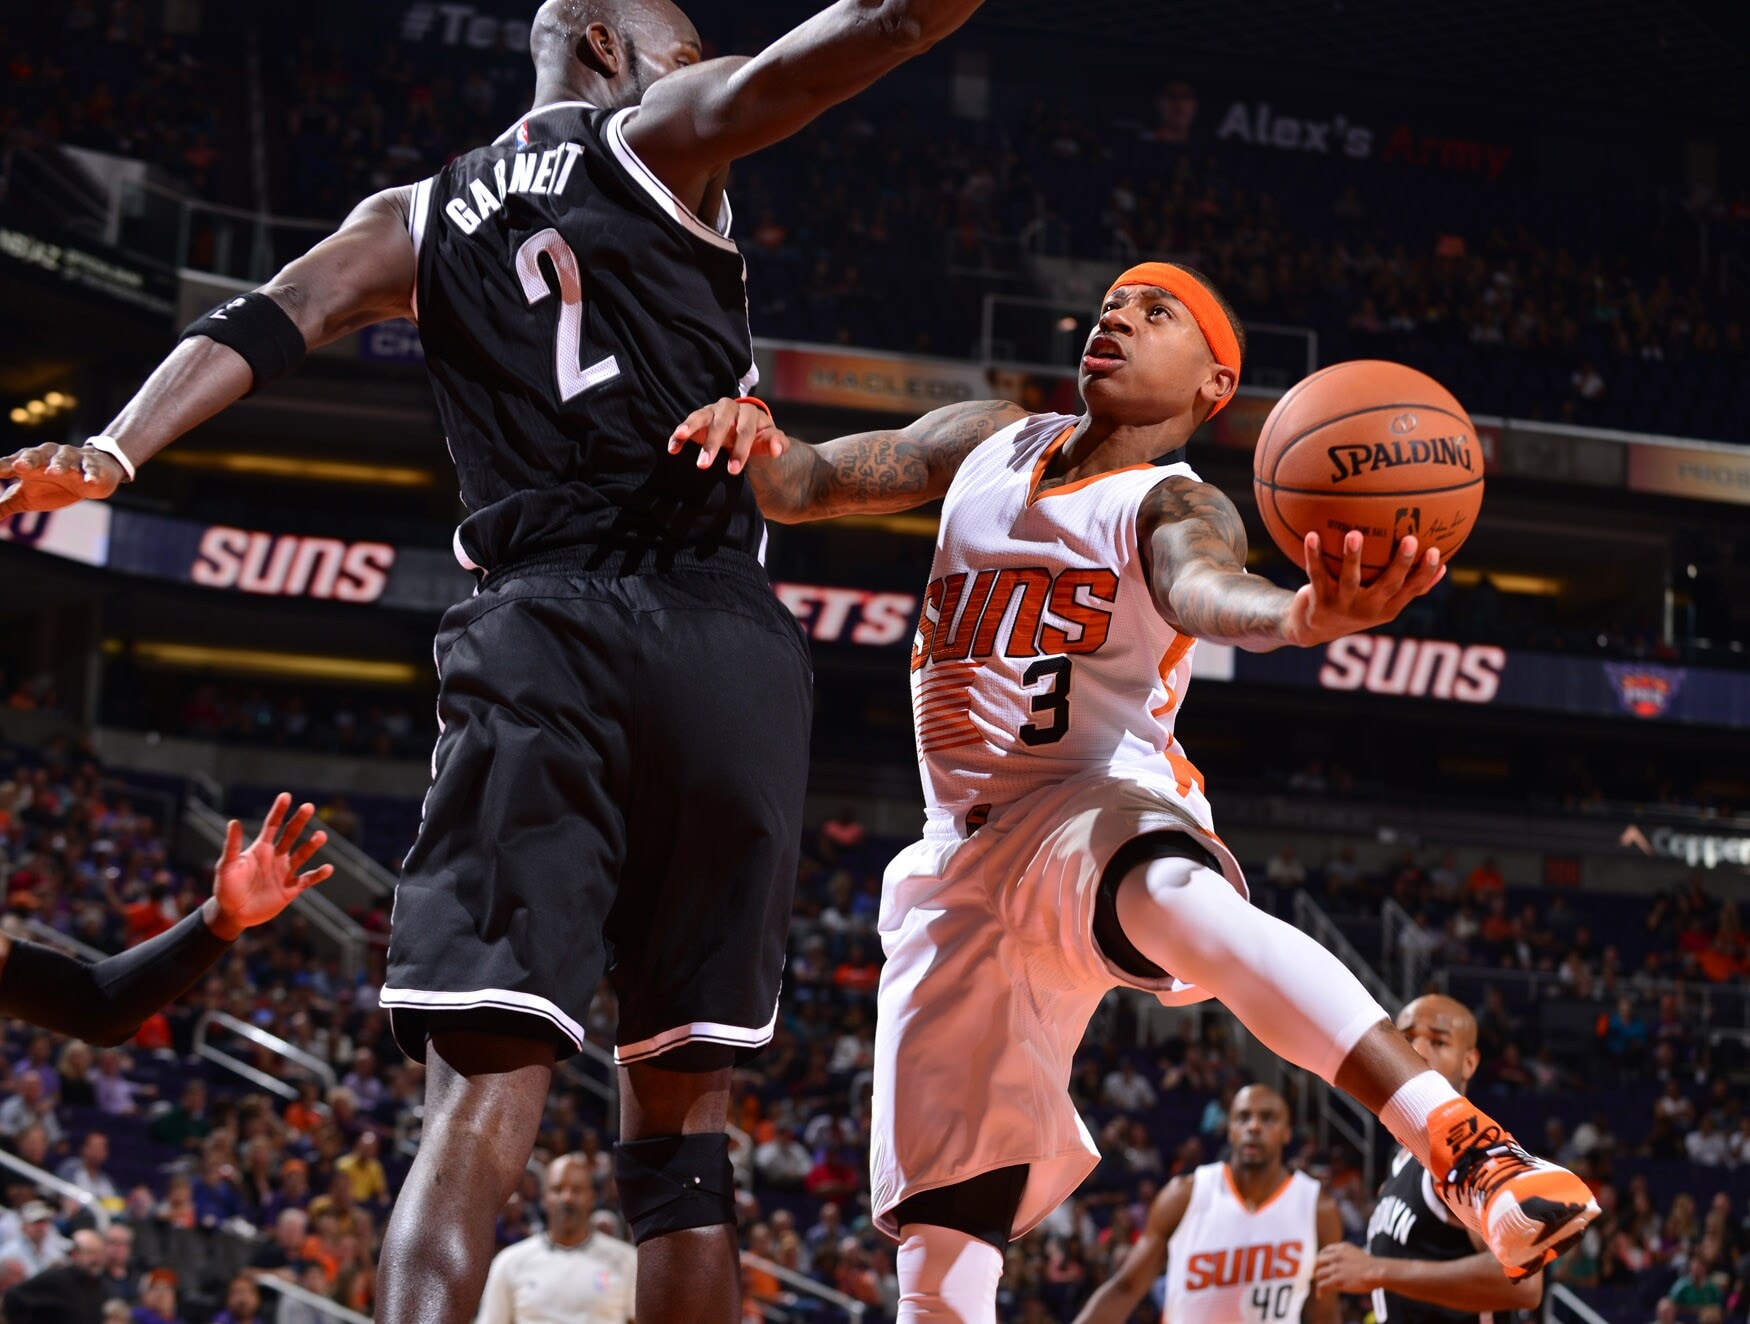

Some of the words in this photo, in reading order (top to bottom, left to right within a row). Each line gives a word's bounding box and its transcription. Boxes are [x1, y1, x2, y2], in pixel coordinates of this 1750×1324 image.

[1215, 101, 1374, 158] Alex's
[1381, 122, 1513, 185] Army
[515, 228, 620, 402] 2
[1328, 435, 1473, 484] SPALDING
[191, 524, 397, 605] SUNS
[911, 567, 1119, 674] SUNS
[1019, 655, 1072, 747] 3
[1318, 633, 1508, 704] SUNS
[1186, 1242, 1303, 1291] SUNS
[1252, 1284, 1294, 1321] 40
